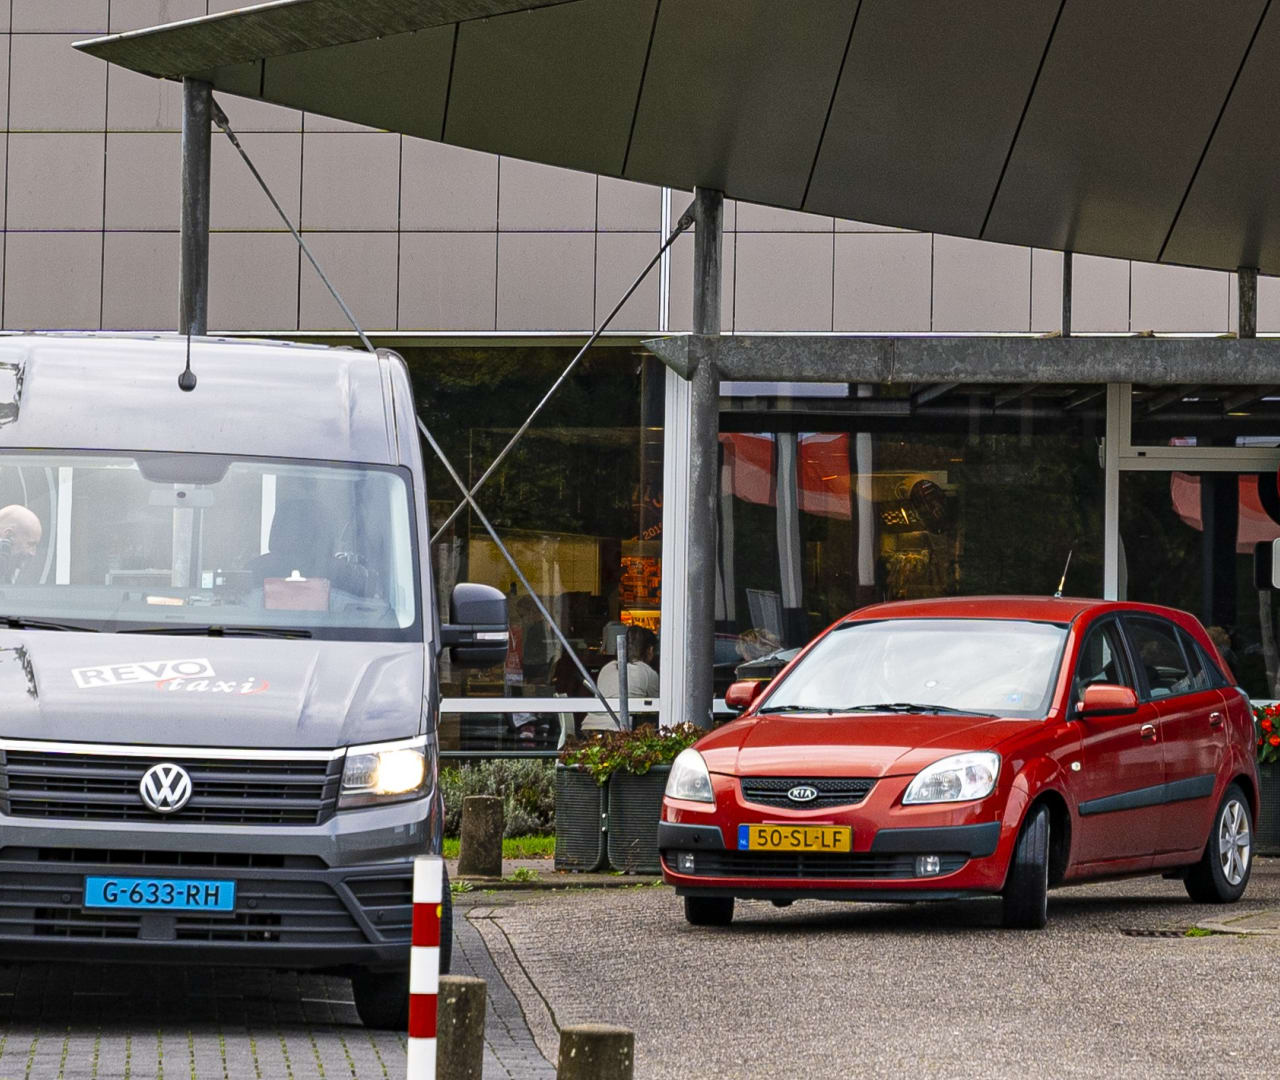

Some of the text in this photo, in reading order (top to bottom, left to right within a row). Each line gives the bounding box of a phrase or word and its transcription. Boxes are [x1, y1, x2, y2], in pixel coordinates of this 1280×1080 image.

[78, 660, 208, 686] REVO
[168, 676, 255, 694] taxi
[792, 789, 812, 798] KIA
[757, 829, 842, 848] 50-SL-LF
[102, 881, 220, 906] G-633-RH
